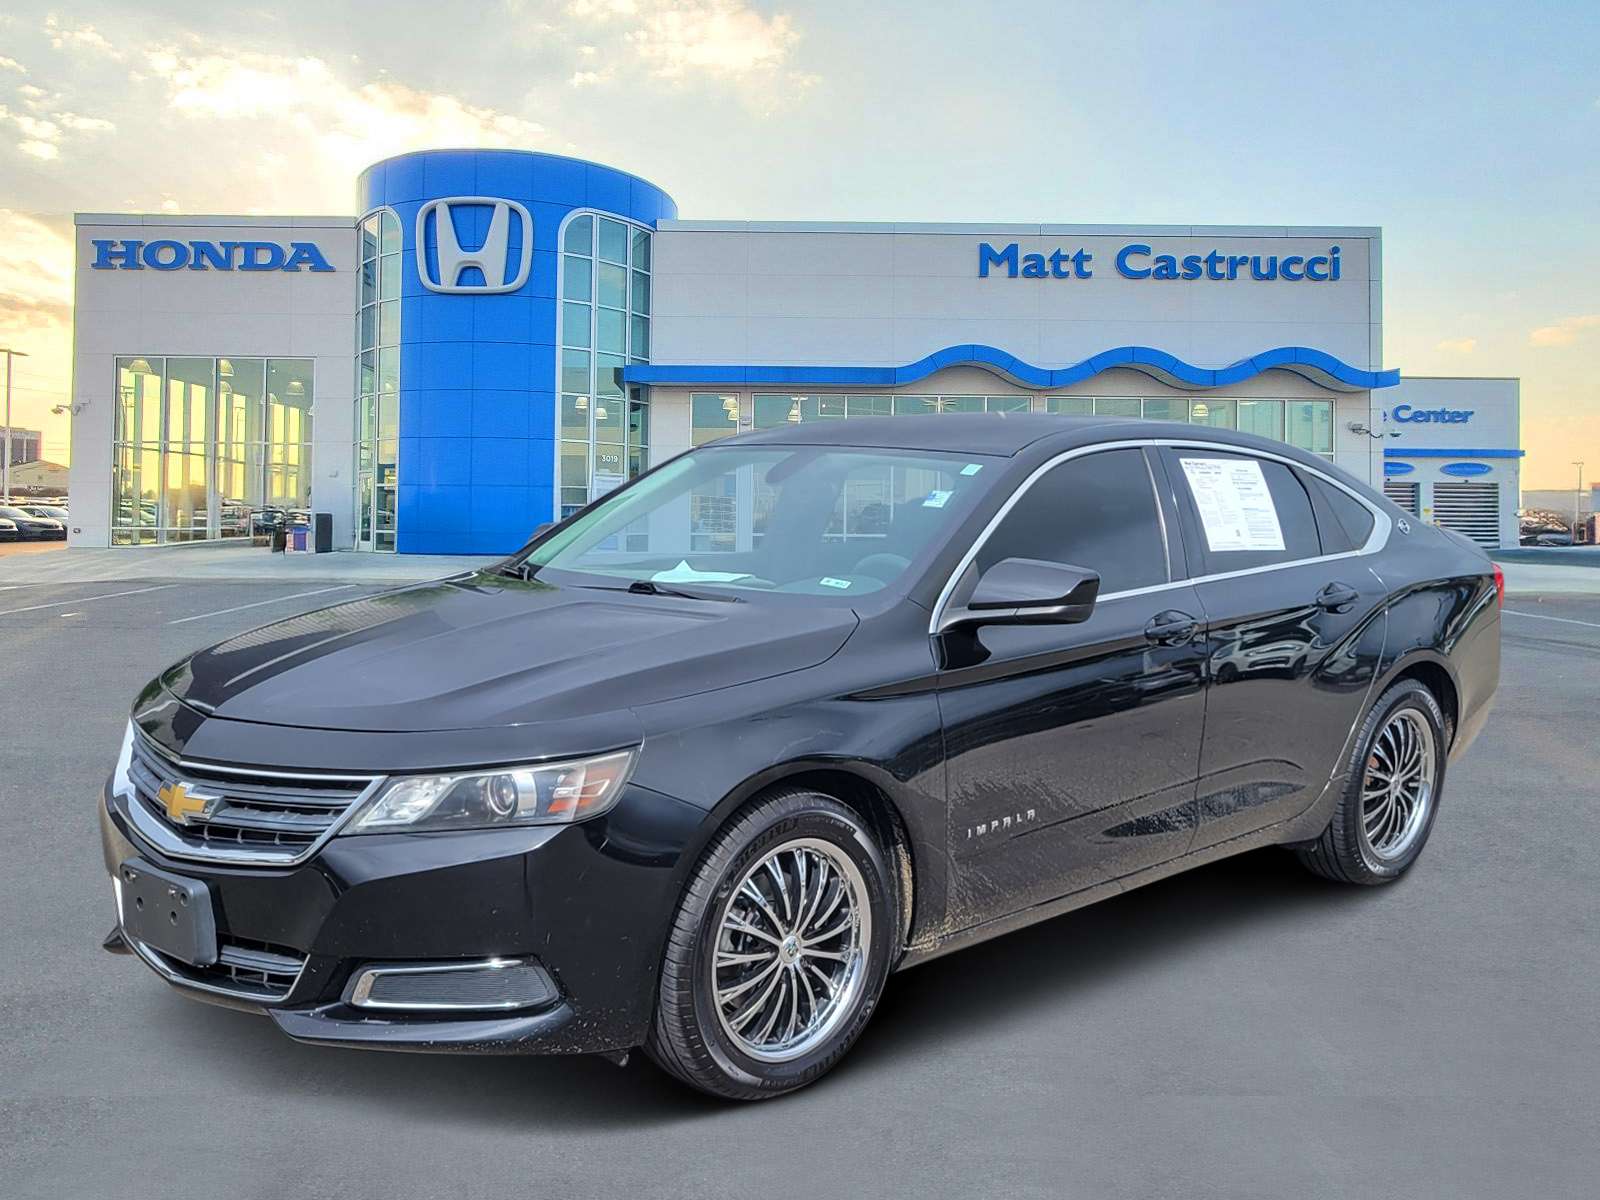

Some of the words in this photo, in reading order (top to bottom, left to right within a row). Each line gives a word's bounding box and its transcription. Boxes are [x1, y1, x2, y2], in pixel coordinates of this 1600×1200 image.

[91, 239, 336, 272] HONDA
[978, 242, 1093, 279] Matt
[1114, 243, 1342, 281] Castrucci
[1392, 404, 1475, 424] Center
[601, 454, 618, 463] 3019
[966, 808, 1036, 840] IMPALA
[731, 817, 799, 873] MICHELIN
